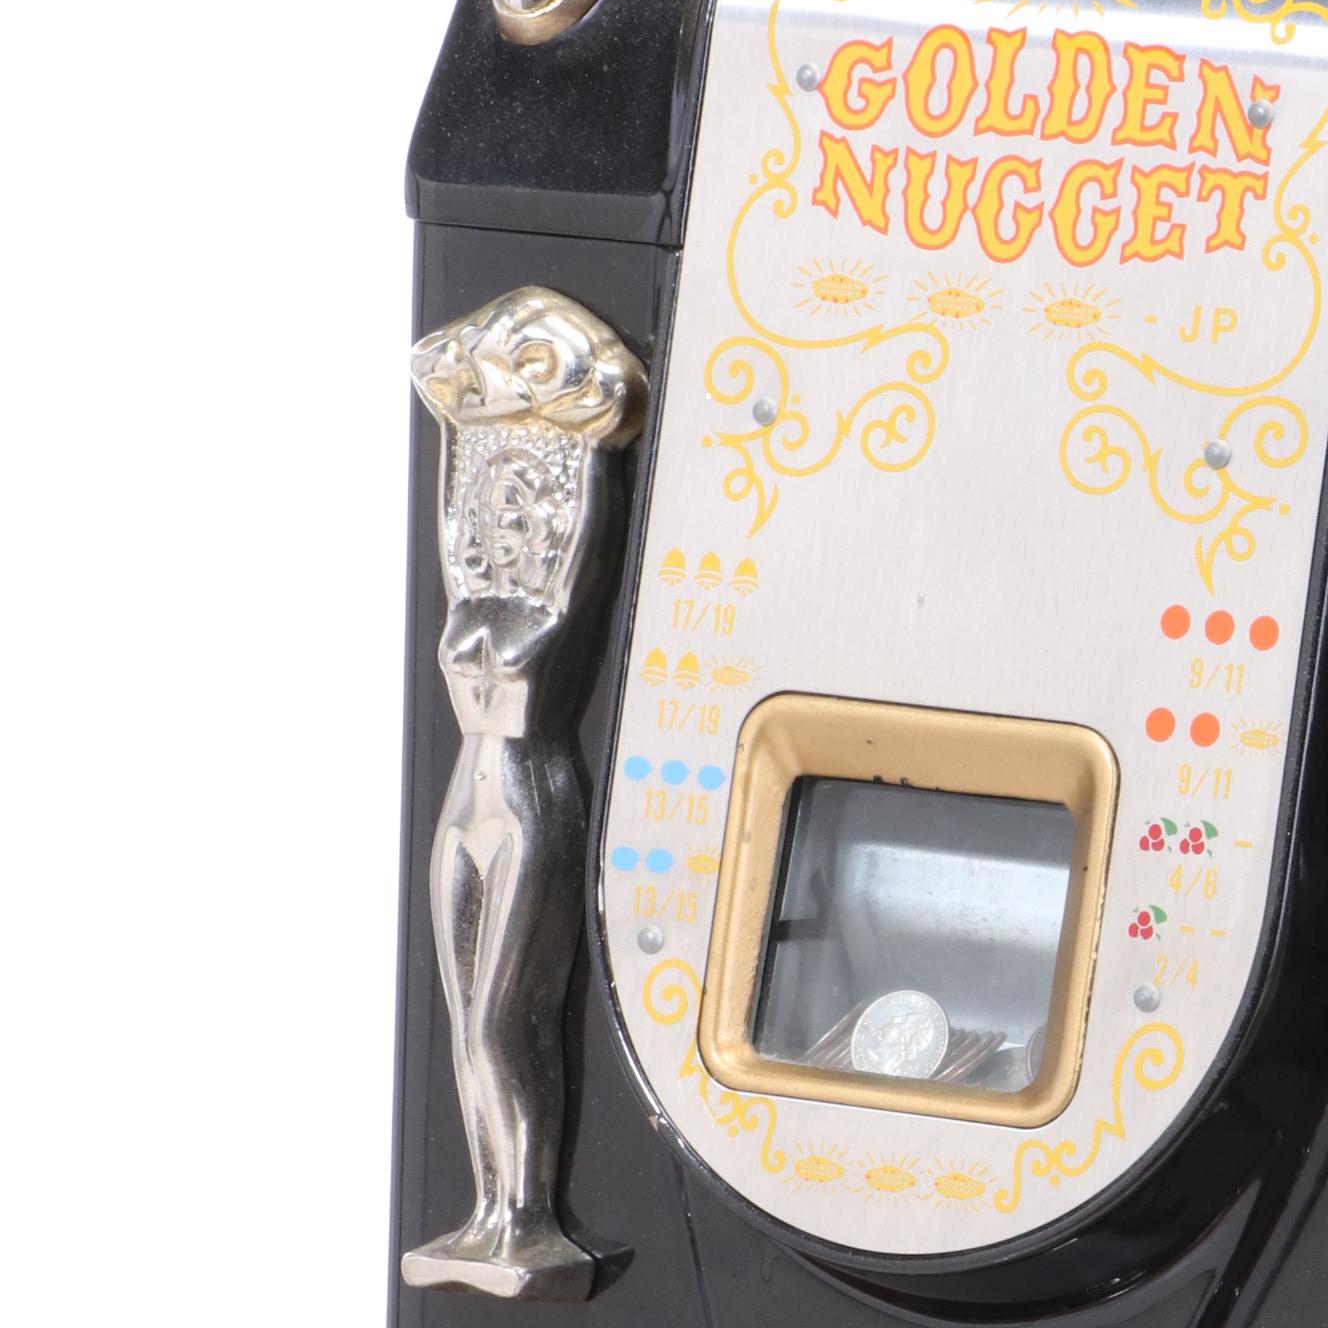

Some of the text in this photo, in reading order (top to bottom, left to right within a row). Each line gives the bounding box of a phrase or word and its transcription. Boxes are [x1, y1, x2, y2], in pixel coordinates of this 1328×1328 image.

[816, 24, 1281, 164] GOLDEN
[811, 132, 1269, 266] NUGGET
[672, 598, 736, 635] 17/19
[1189, 656, 1245, 695] 9/11
[657, 698, 720, 736] 17/19
[1177, 762, 1232, 801] 9/11
[644, 788, 709, 826] 13/15
[1169, 863, 1218, 900] 4/6
[633, 884, 698, 924] 13/15
[1153, 951, 1199, 990] 2/4
